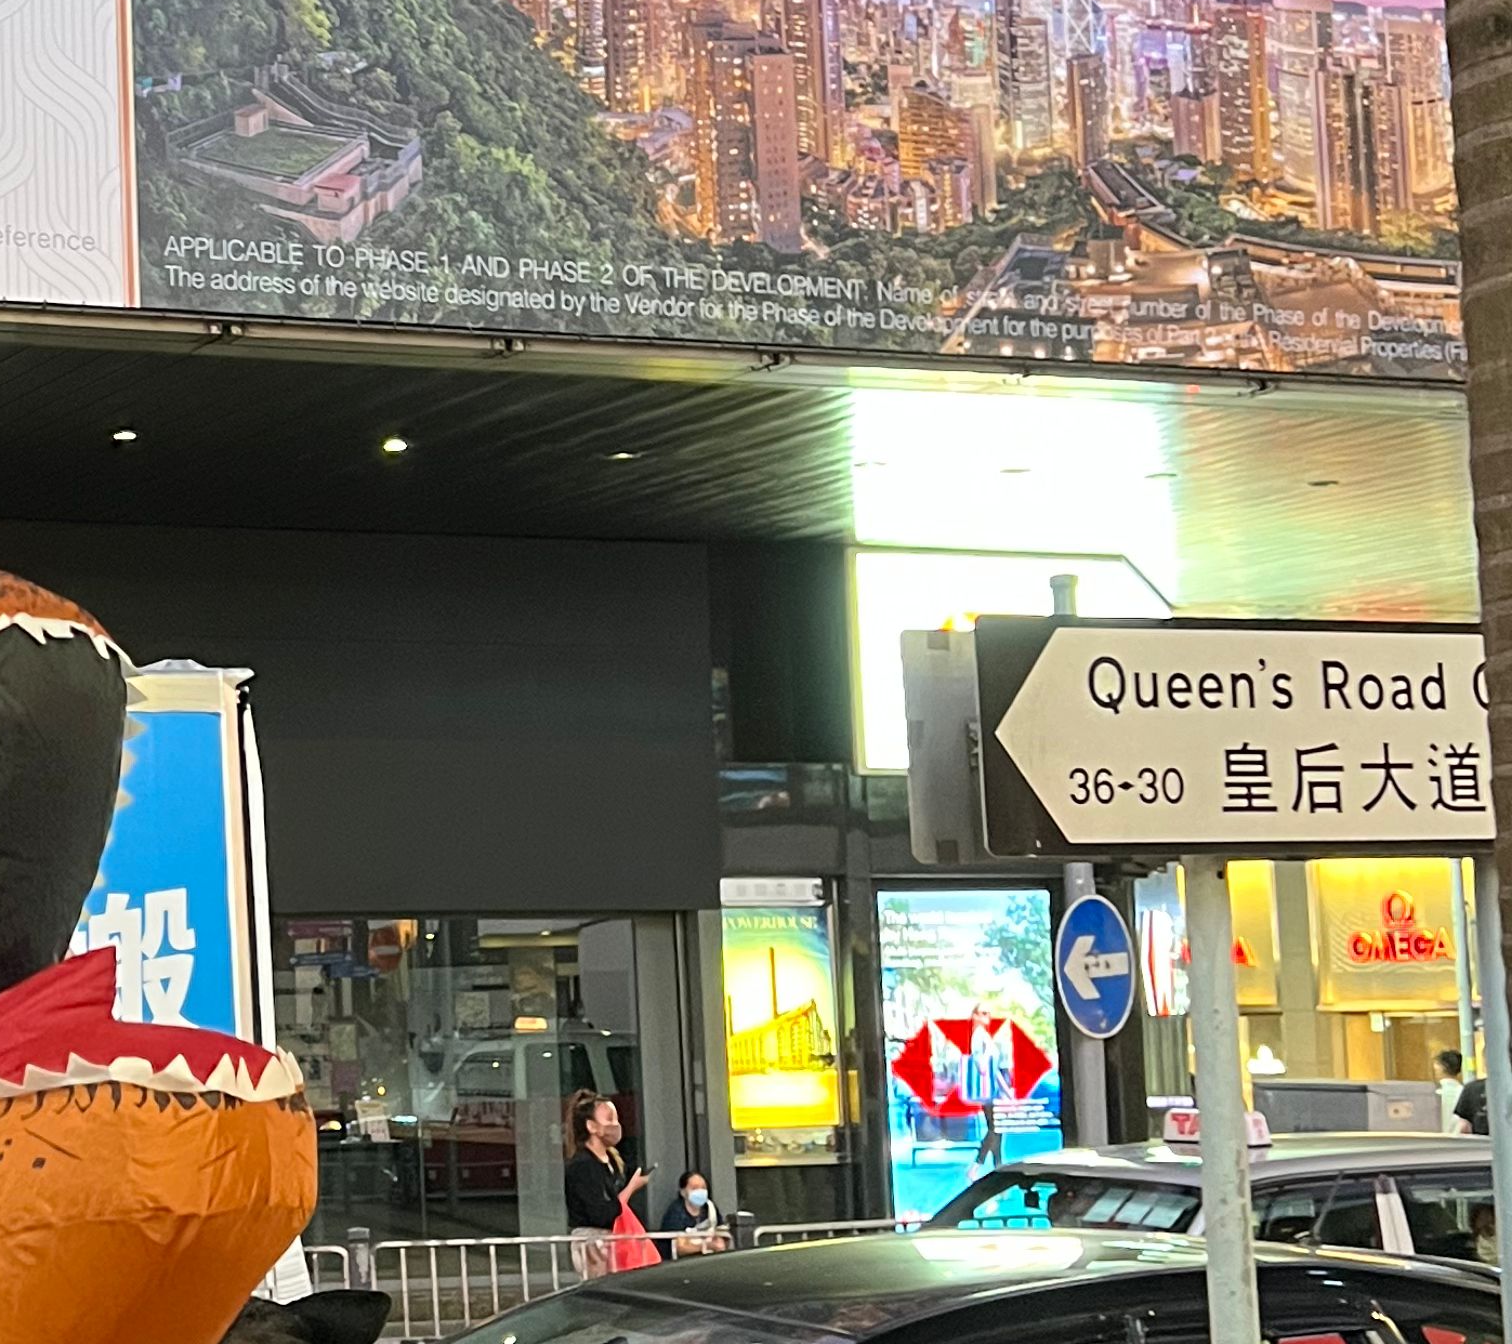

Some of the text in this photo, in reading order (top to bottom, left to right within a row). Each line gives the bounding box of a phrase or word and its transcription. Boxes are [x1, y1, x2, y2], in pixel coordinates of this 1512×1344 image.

[163, 235, 304, 266] APPLICABLE
[312, 244, 345, 268] TO
[354, 247, 429, 274] PHASE
[439, 254, 450, 274] 1
[461, 254, 510, 279] AND
[518, 257, 591, 284] PHASE
[599, 262, 615, 286] 2
[622, 264, 654, 288] OF
[661, 266, 705, 291] THE
[876, 279, 934, 306] Name
[1194, 299, 1212, 320] of
[1219, 301, 1247, 322] the
[1252, 302, 1305, 326] Phase
[1311, 307, 1329, 327] of
[1334, 309, 1362, 330] the
[163, 264, 206, 289] The
[209, 269, 296, 294] address
[299, 273, 322, 297] of
[324, 275, 358, 299] the
[361, 278, 440, 304] website
[444, 284, 555, 312] designated
[560, 291, 586, 316] by
[589, 292, 620, 314] the
[624, 292, 696, 319] Vendor
[699, 297, 724, 320] for
[727, 299, 759, 322] the
[762, 300, 821, 327] Phase
[823, 302, 843, 327] of
[846, 304, 876, 329] the
[1002, 314, 1027, 337] for
[1029, 316, 1058, 338] the
[1360, 334, 1444, 361] Properties
[1087, 656, 1294, 714] Queen's
[1321, 660, 1447, 711] Road
[1068, 767, 1185, 805] 36-30
[1221, 741, 1487, 814] 皇后大道
[1348, 926, 1457, 963] OMEGA
